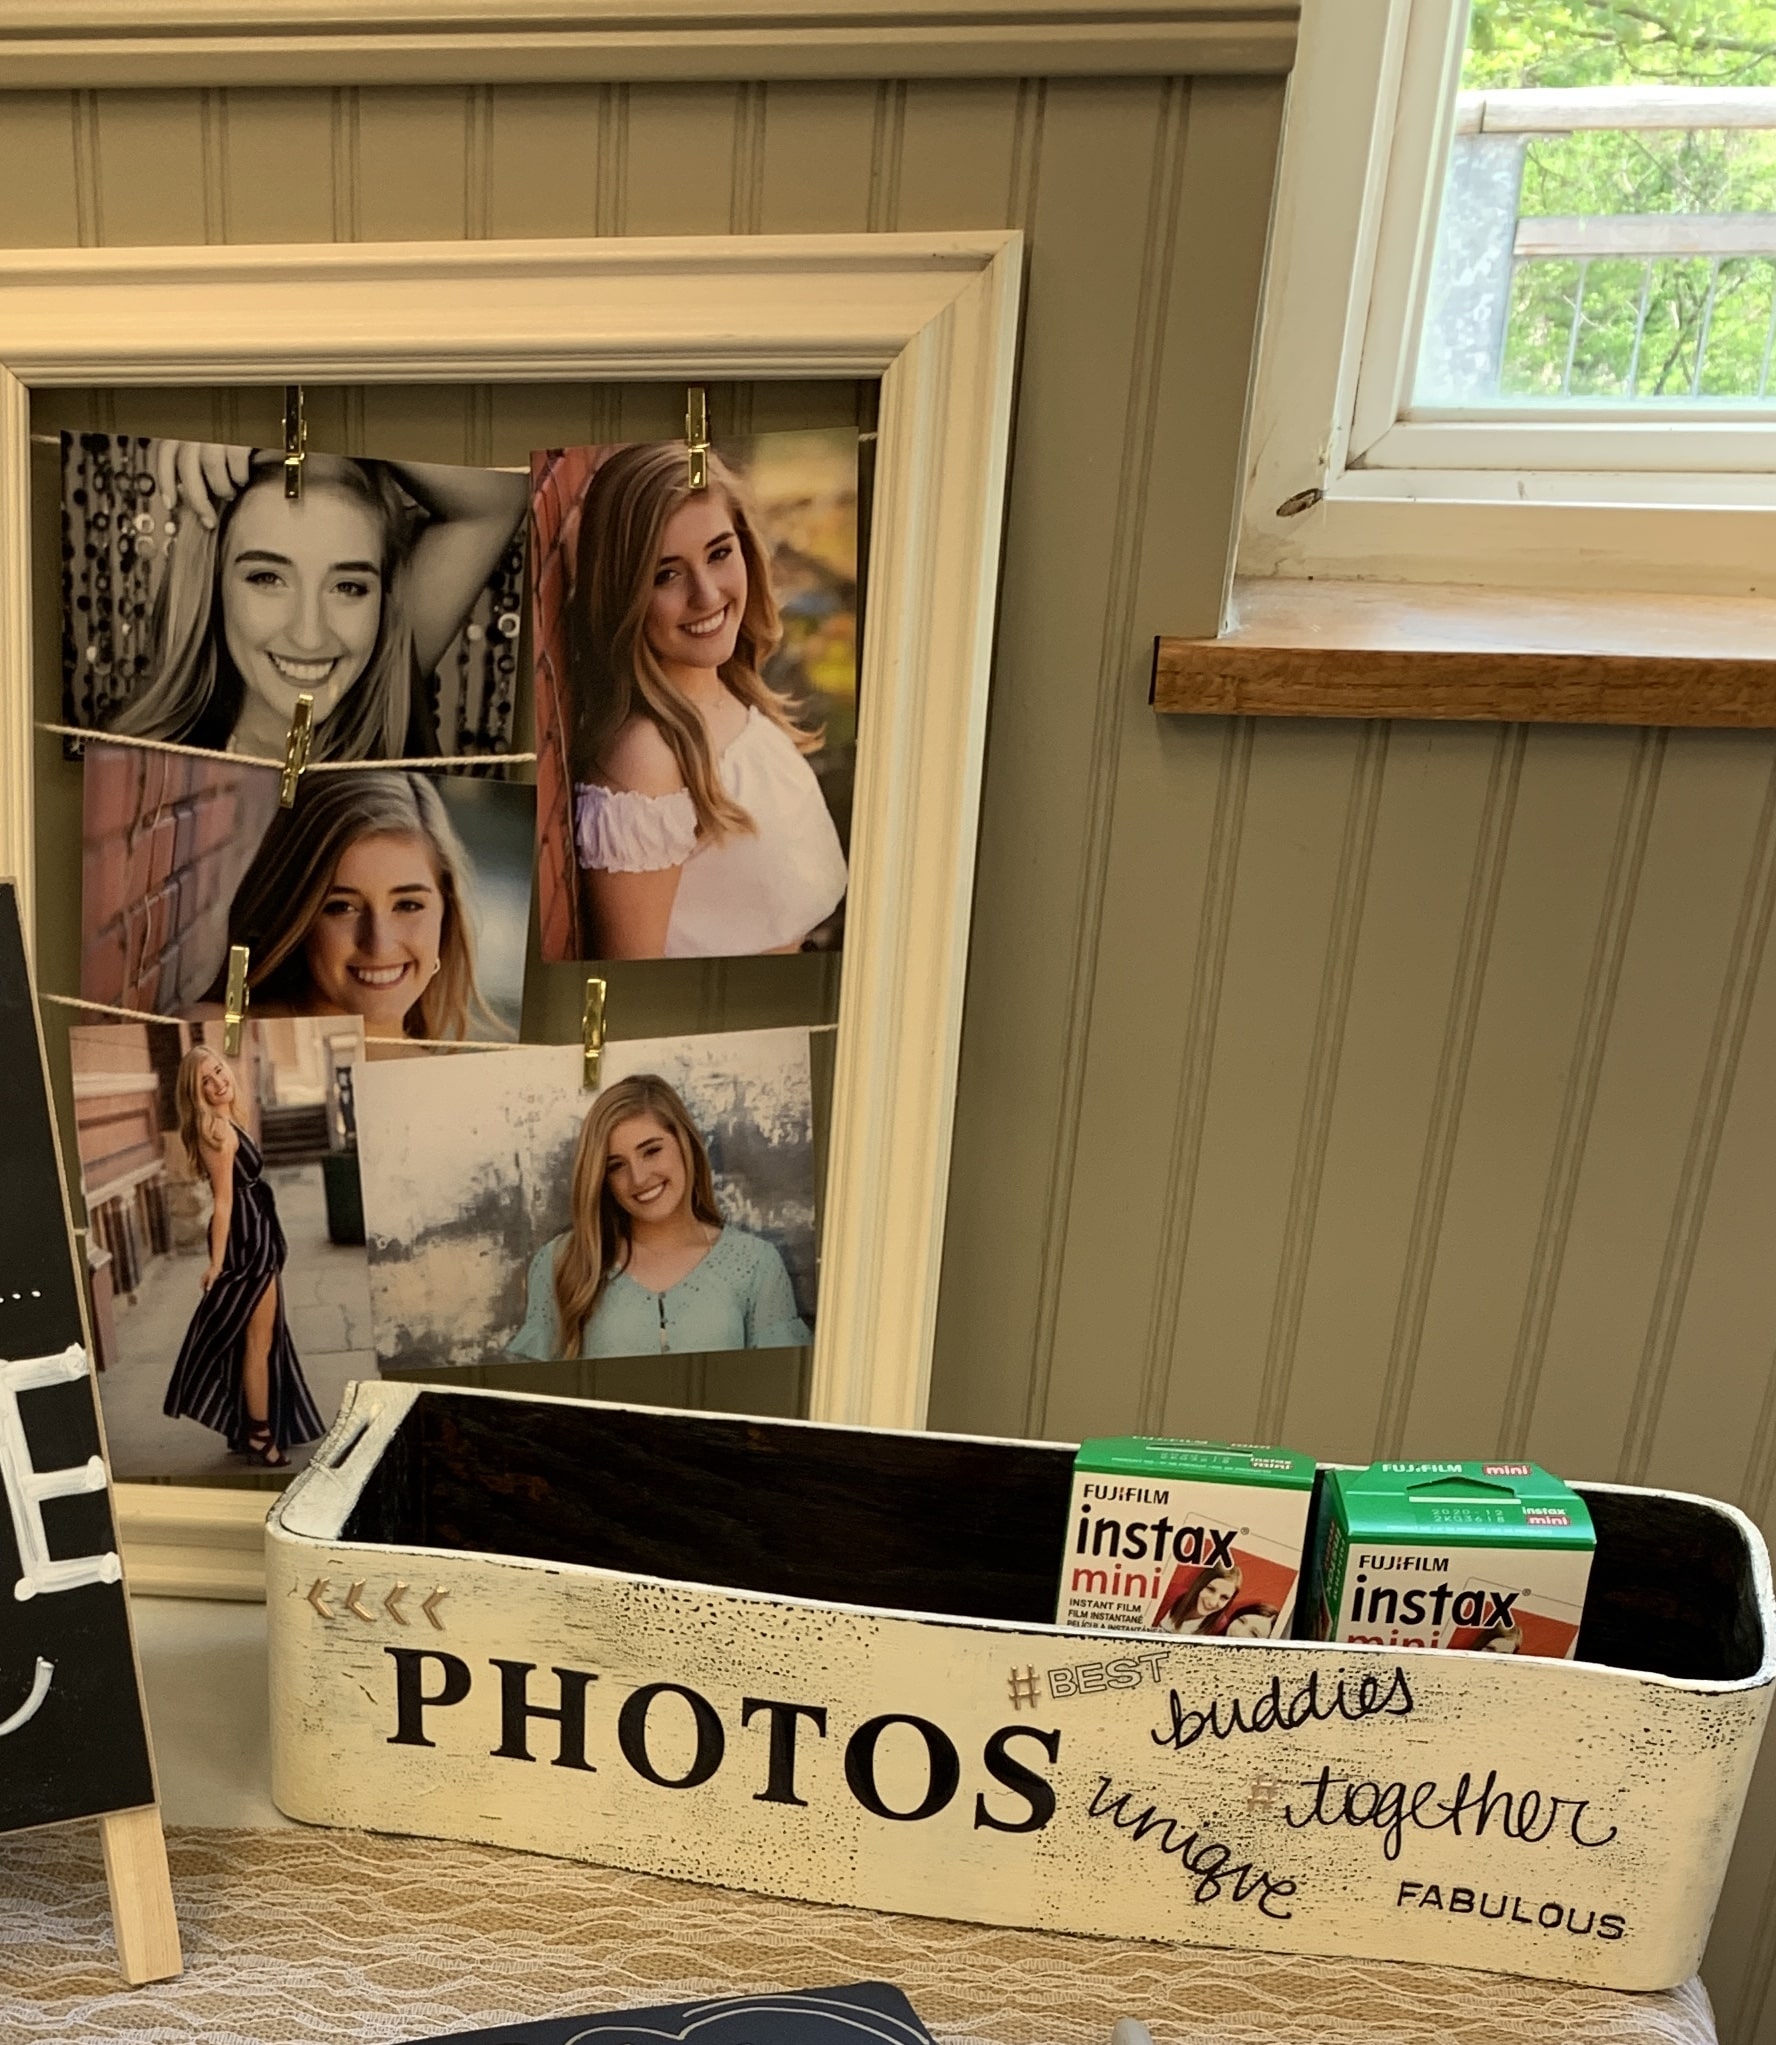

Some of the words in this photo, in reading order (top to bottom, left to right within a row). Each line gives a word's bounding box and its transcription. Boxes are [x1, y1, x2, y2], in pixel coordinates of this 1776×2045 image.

[1382, 1463, 1463, 1474] FUJIFILM
[1485, 1464, 1529, 1476] mini
[1083, 1483, 1170, 1505] FUJIFILM
[1522, 1505, 1567, 1516] instax
[1529, 1515, 1569, 1527] mini
[1359, 1554, 1450, 1572] FUJIFILM
[1071, 1562, 1162, 1599] mini
[1069, 1597, 1115, 1611] INSTANT
[1116, 1602, 1142, 1613] FILM
[1067, 1608, 1089, 1619] FILM
[1089, 1611, 1144, 1624] INSTANTANÉ
[1150, 1665, 1415, 1751] buddies
[383, 1645, 1061, 1833] PHOTOS
[1086, 1774, 1298, 1922] unique
[1396, 1879, 1628, 1940] FABULOUS
